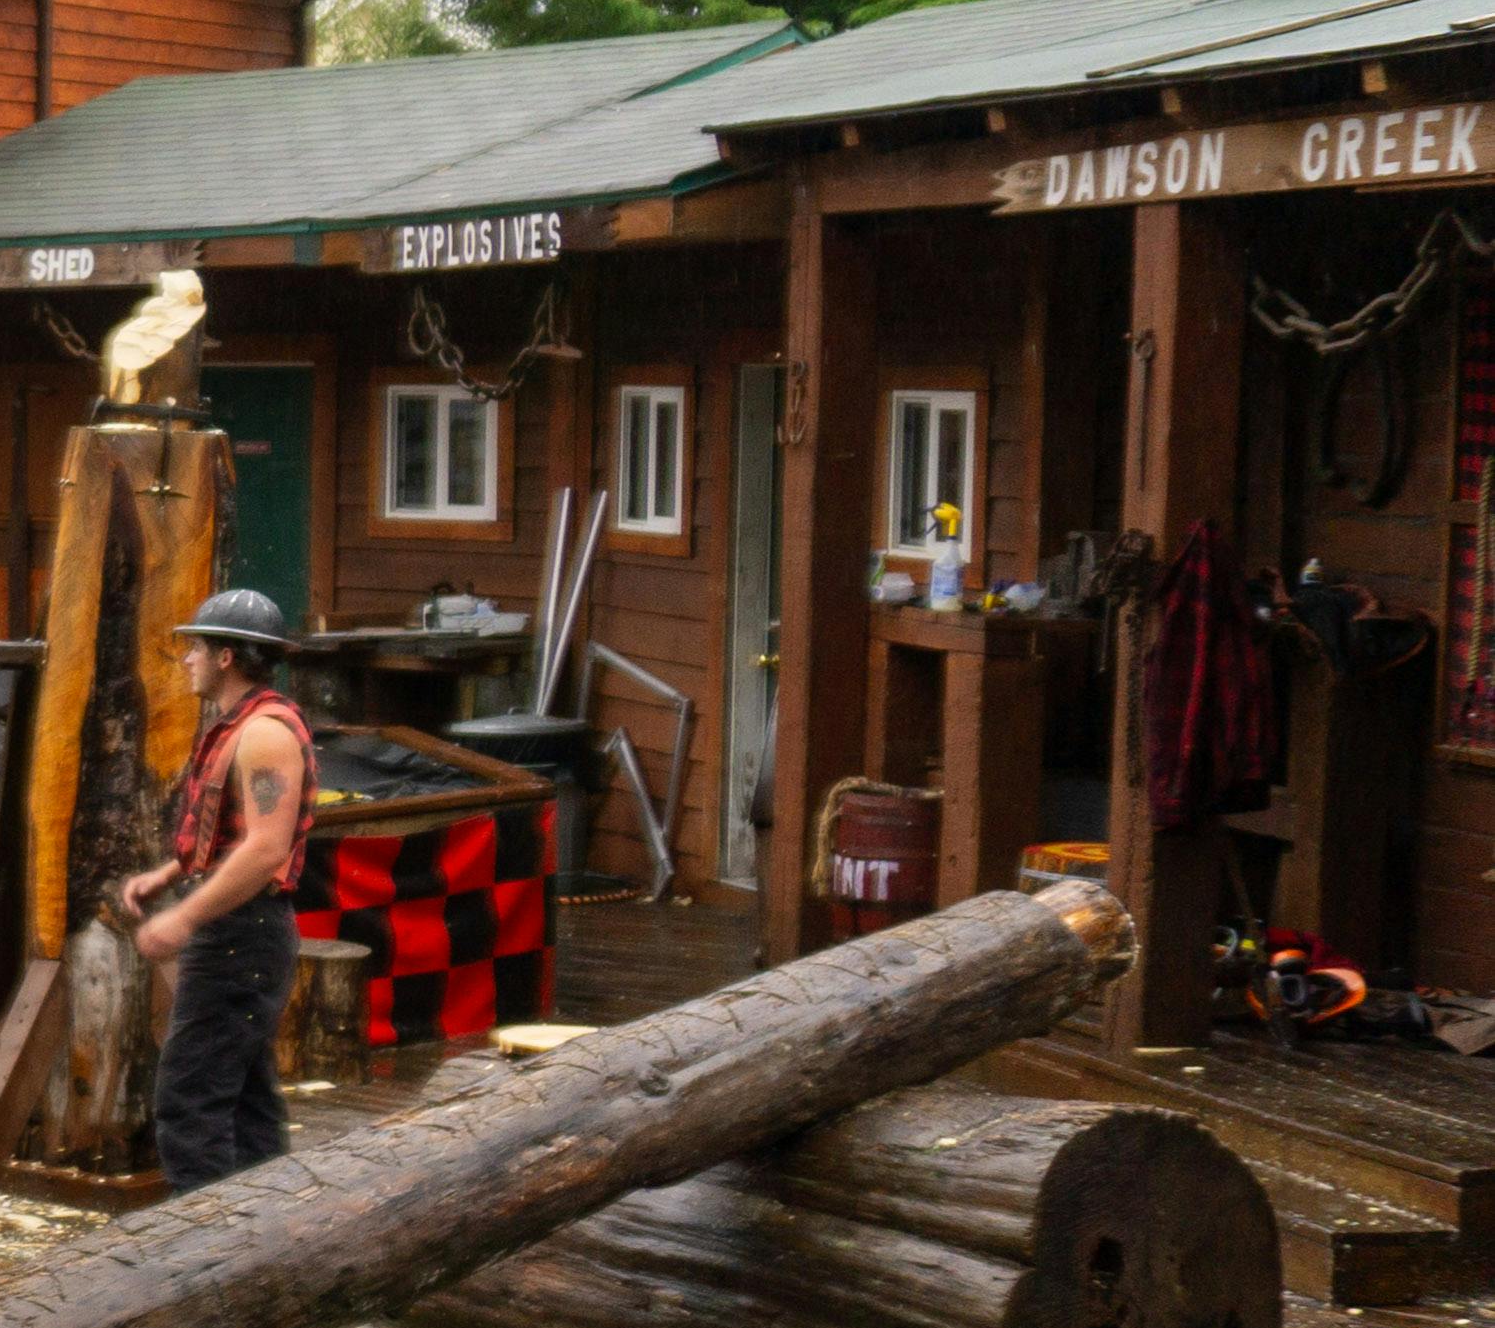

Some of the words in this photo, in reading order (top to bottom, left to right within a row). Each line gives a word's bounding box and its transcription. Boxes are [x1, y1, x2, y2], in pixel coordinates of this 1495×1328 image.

[1044, 132, 1225, 206] DAWSON
[1300, 104, 1483, 183] CREEK
[30, 247, 95, 281] SHED
[402, 212, 562, 269] EXPLOSIVES
